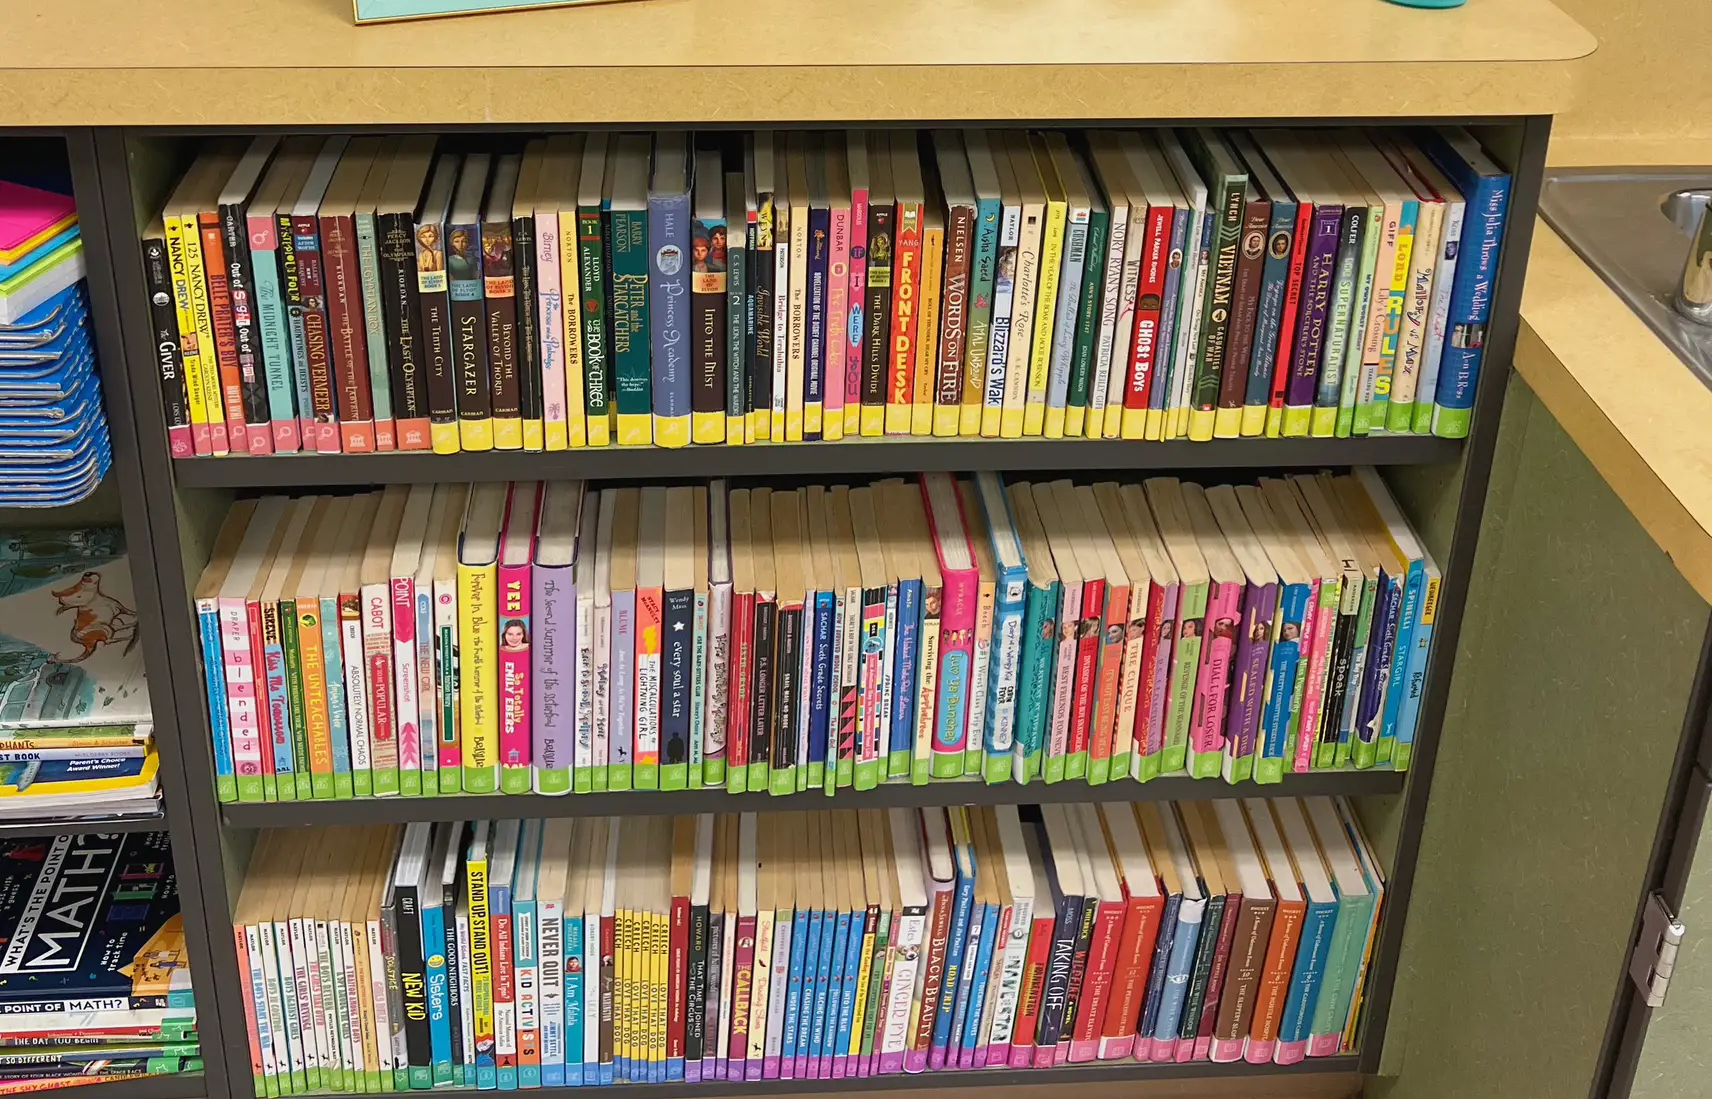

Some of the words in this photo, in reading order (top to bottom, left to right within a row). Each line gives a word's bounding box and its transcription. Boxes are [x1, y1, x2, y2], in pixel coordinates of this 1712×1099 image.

[172, 237, 185, 276] NANCY
[1213, 244, 1235, 304] VIETNAM
[175, 276, 189, 310] DREW
[899, 252, 914, 332] FRONT
[1316, 253, 1332, 312] HARRY
[1136, 320, 1154, 353] GHOST
[1303, 319, 1322, 378] POTTER
[160, 341, 176, 380] GIVER
[461, 316, 477, 396] STARGAZER
[894, 337, 910, 404] DESK
[1134, 356, 1148, 392] BOYS
[371, 596, 384, 629] CABOT
[507, 580, 521, 612] YEE
[1403, 589, 1416, 630] SPINELLI
[305, 645, 318, 669] THE
[672, 641, 683, 667] every
[1393, 646, 1407, 687] STARGIRL
[673, 670, 684, 690] soul
[308, 674, 328, 766] UNTEACHABLES
[672, 699, 680, 717] star
[471, 871, 483, 901] STAND
[5, 916, 35, 966] WHAT'S
[28, 888, 47, 913] THE
[41, 847, 62, 884] POINT
[472, 920, 488, 952] STAND
[542, 918, 560, 958] NEVER
[473, 951, 489, 977] OUT!
[541, 960, 559, 989] QUIT
[1050, 935, 1074, 983] TAKING
[402, 972, 423, 996] NEW
[430, 974, 444, 1020] Sisters
[519, 970, 533, 991] KID
[1046, 983, 1065, 1011] OFF
[5, 1002, 42, 1014] POINT
[47, 1002, 62, 1012] OF
[70, 1000, 123, 1010] MATH?
[521, 994, 535, 1057] ACTIVISTS
